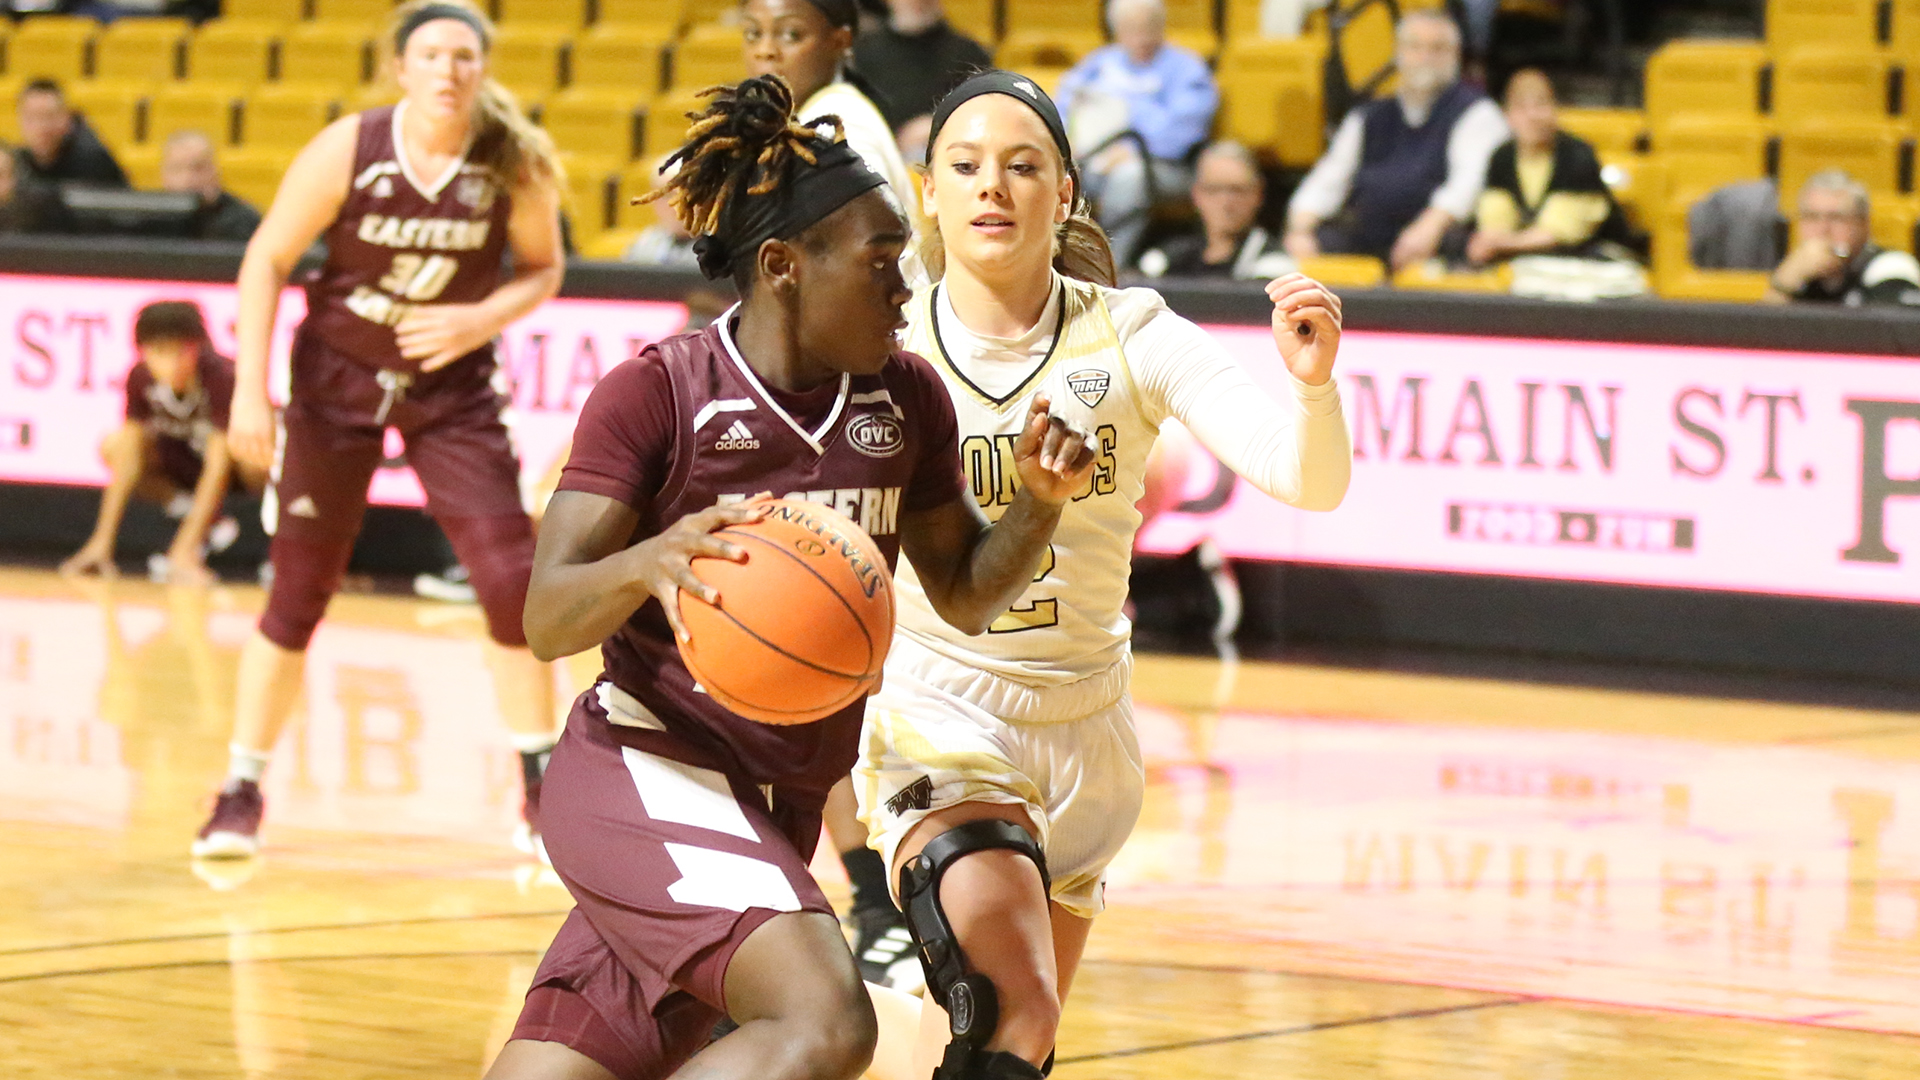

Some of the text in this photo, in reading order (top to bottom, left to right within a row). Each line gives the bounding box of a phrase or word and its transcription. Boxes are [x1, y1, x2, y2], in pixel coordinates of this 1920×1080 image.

[378, 252, 460, 302] 30
[1071, 379, 1108, 393] MAC
[714, 438, 761, 450] adidas
[860, 426, 894, 445] OVC
[1347, 373, 1818, 486] MAIN ST.
[757, 504, 883, 600] SPALDING
